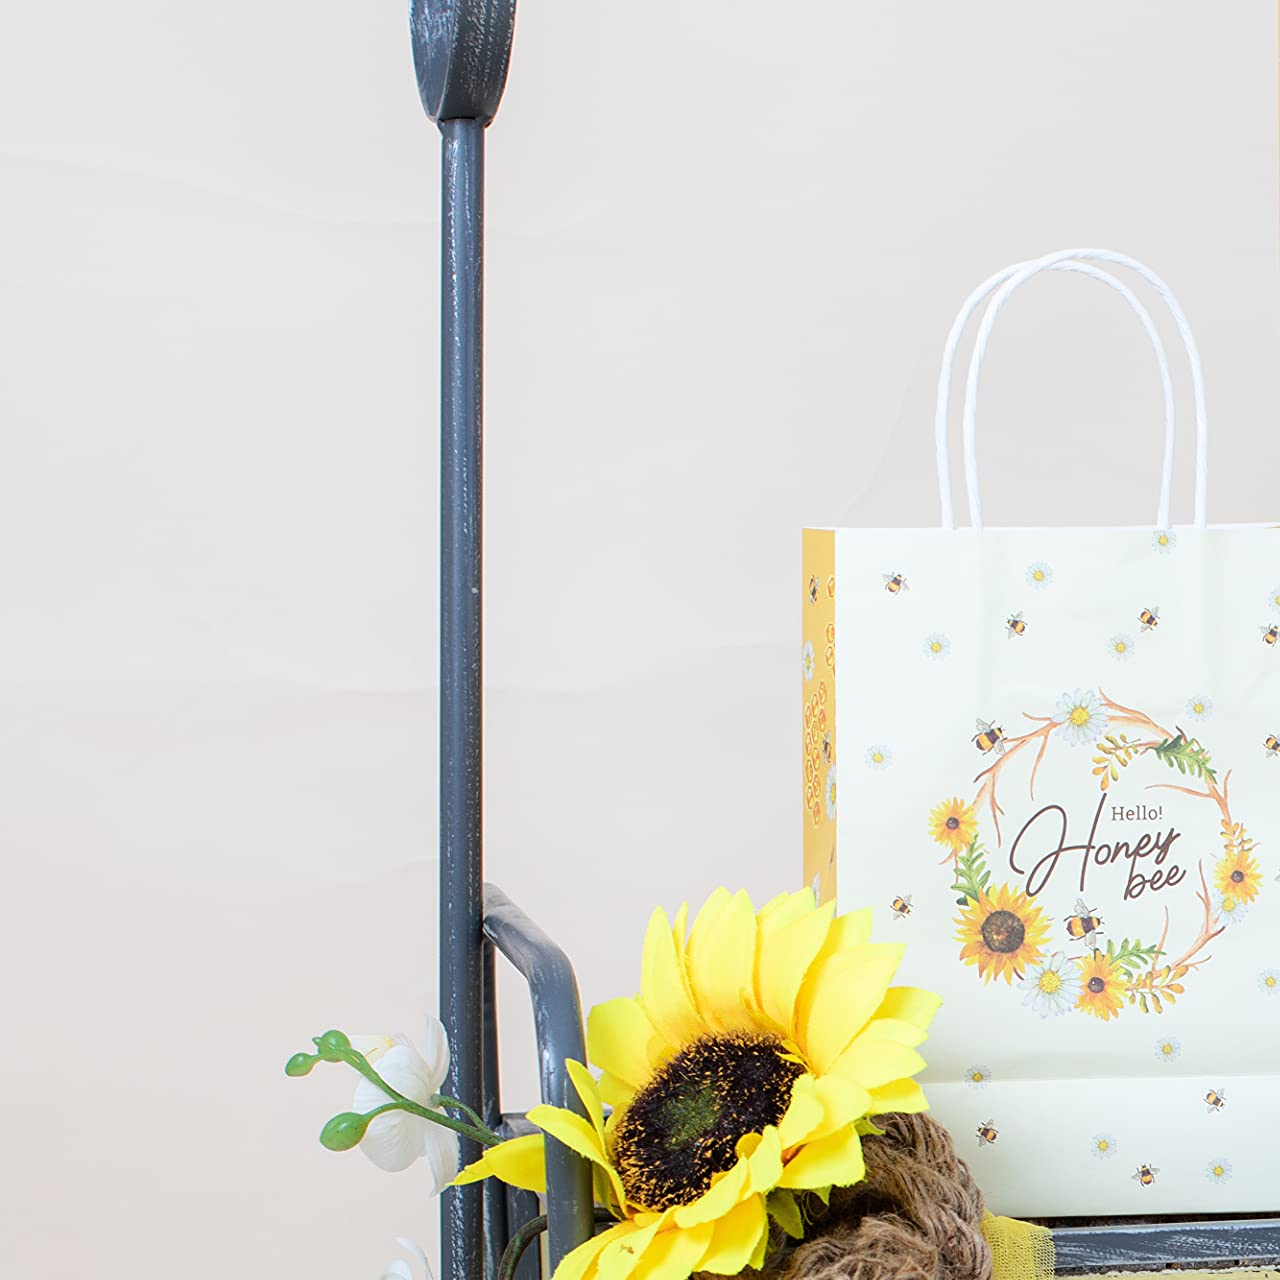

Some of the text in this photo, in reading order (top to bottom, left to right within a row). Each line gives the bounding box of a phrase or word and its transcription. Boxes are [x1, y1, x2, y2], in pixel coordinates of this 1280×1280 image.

[1111, 805, 1163, 821] Hello!
[1009, 792, 1181, 897] Honey
[1123, 855, 1187, 901] bee
